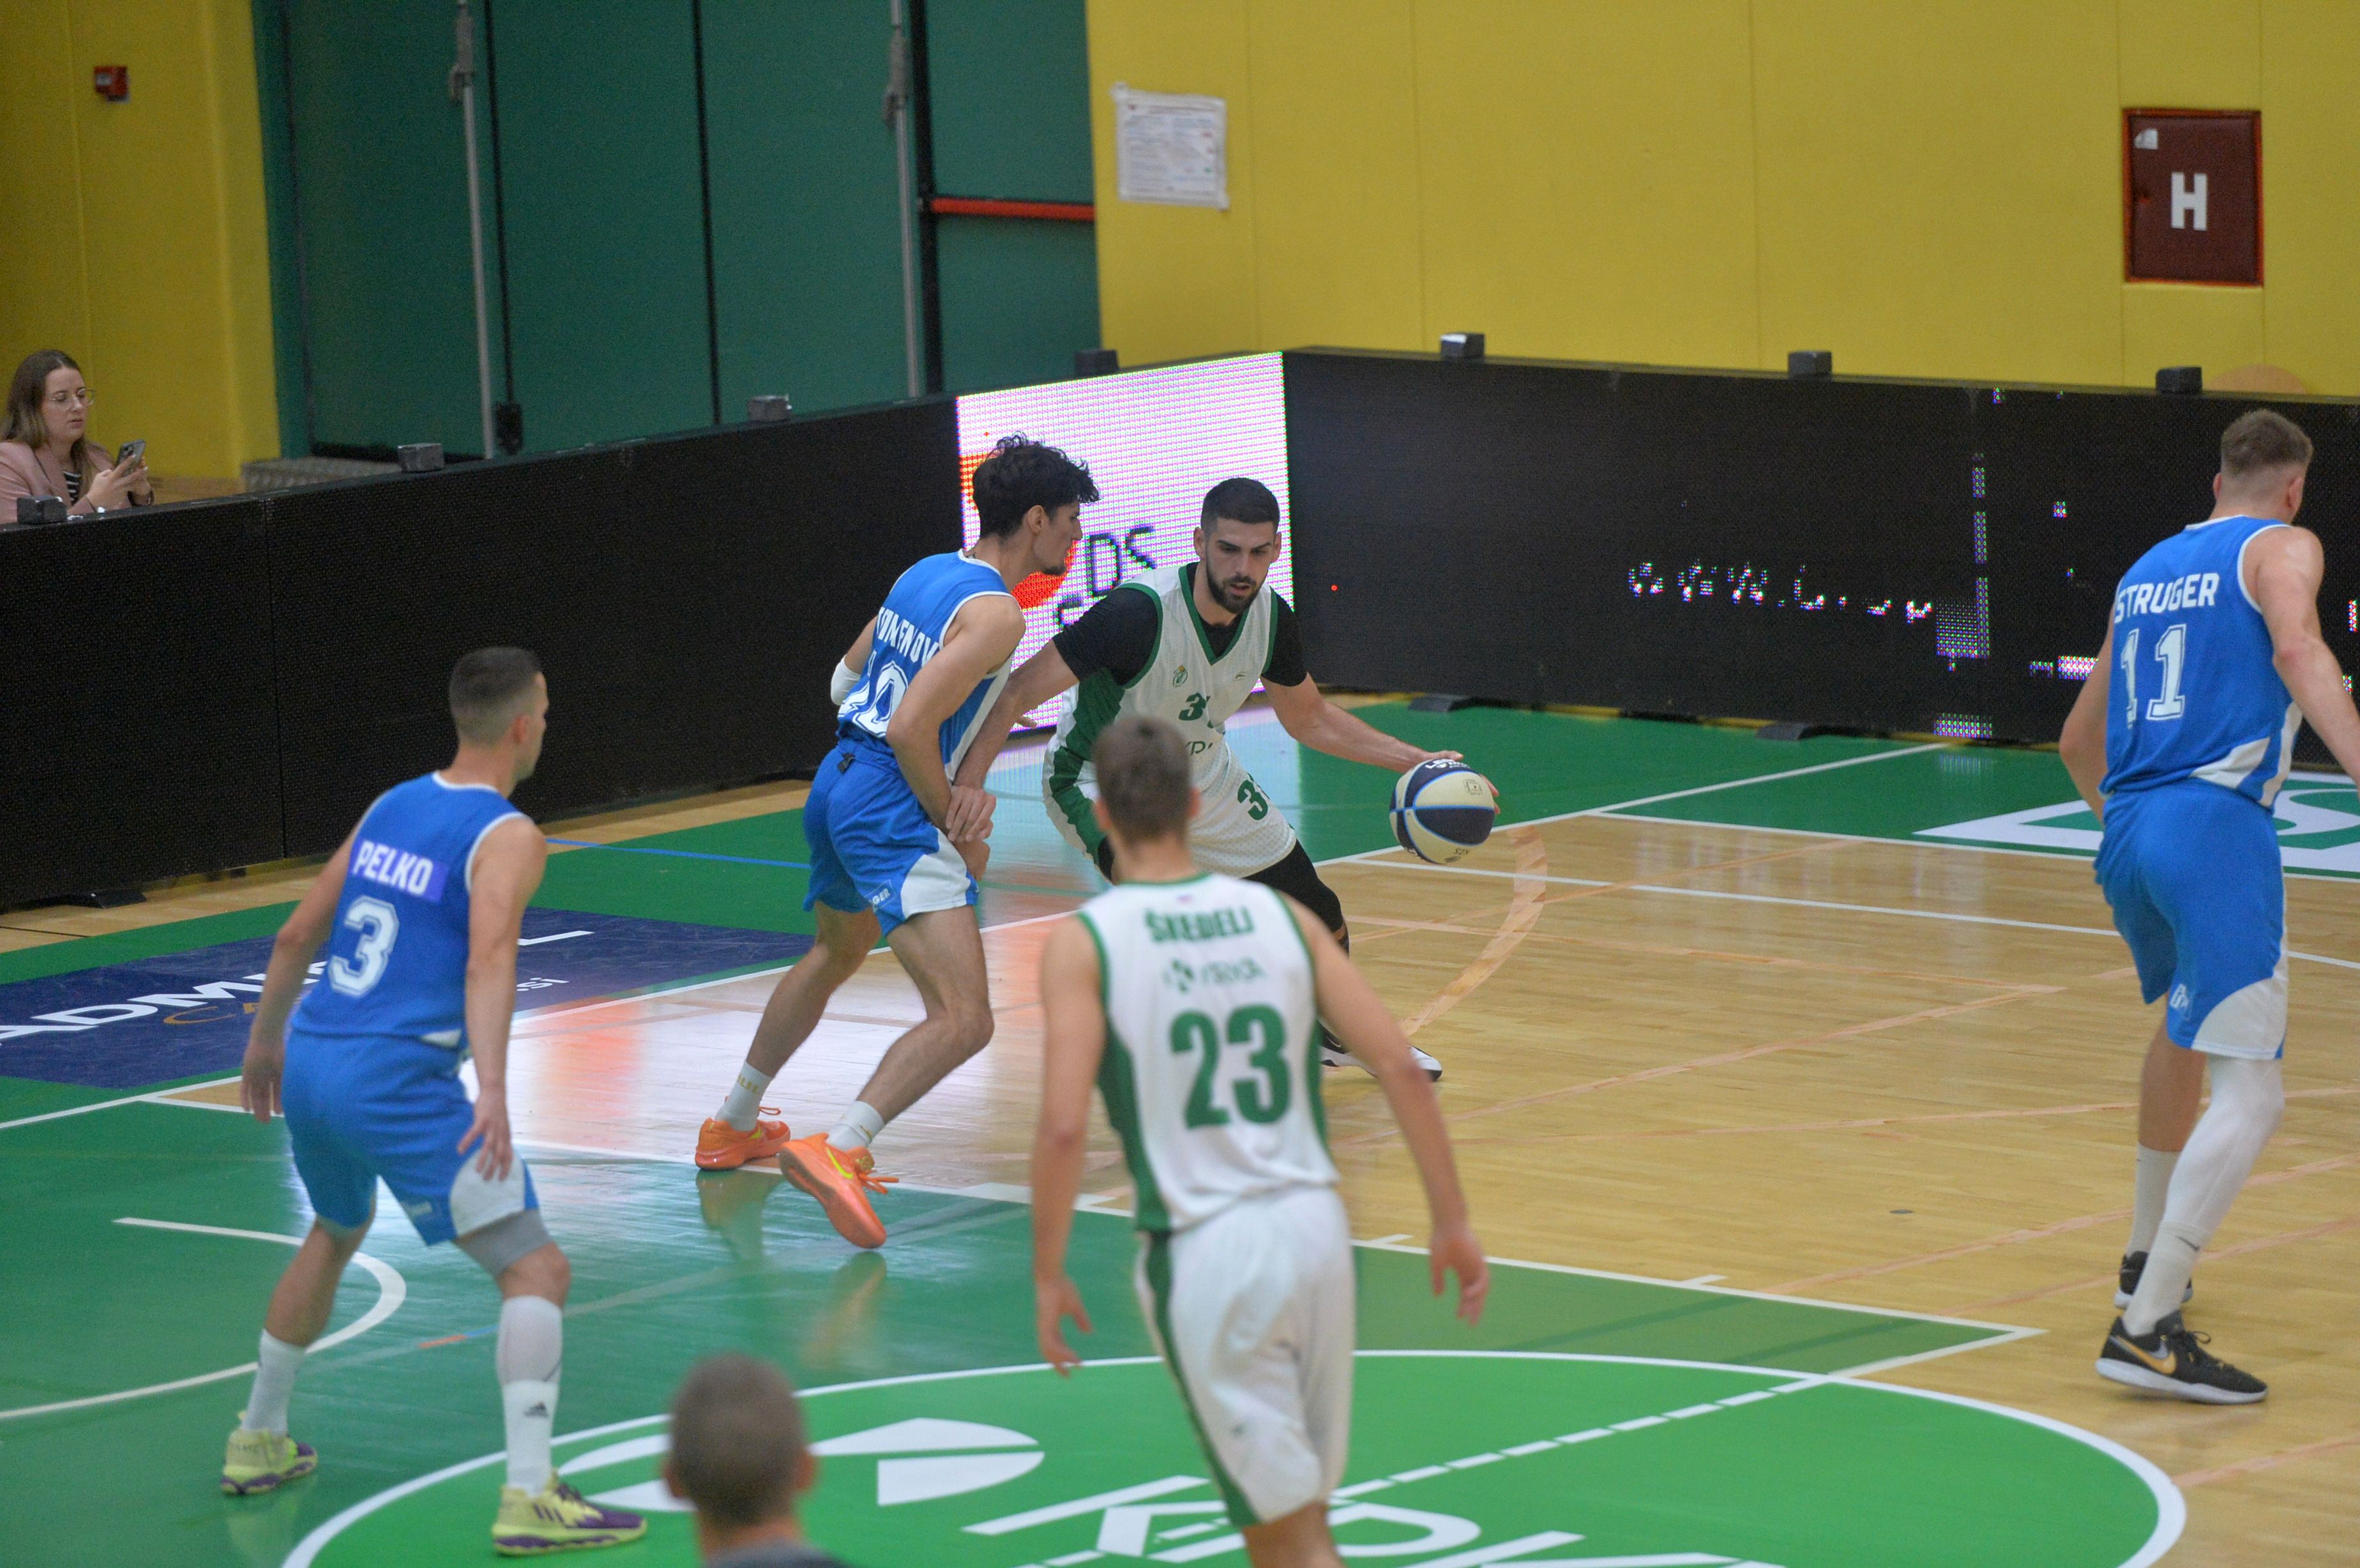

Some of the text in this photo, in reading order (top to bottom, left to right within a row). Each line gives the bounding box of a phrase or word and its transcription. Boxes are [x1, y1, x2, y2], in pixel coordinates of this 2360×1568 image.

[2171, 170, 2207, 231] H
[2114, 572, 2220, 624] STRUGER
[2121, 623, 2186, 729] 11
[352, 840, 434, 894] PELKO
[328, 895, 400, 999] 3
[1170, 1003, 1292, 1129] 23
